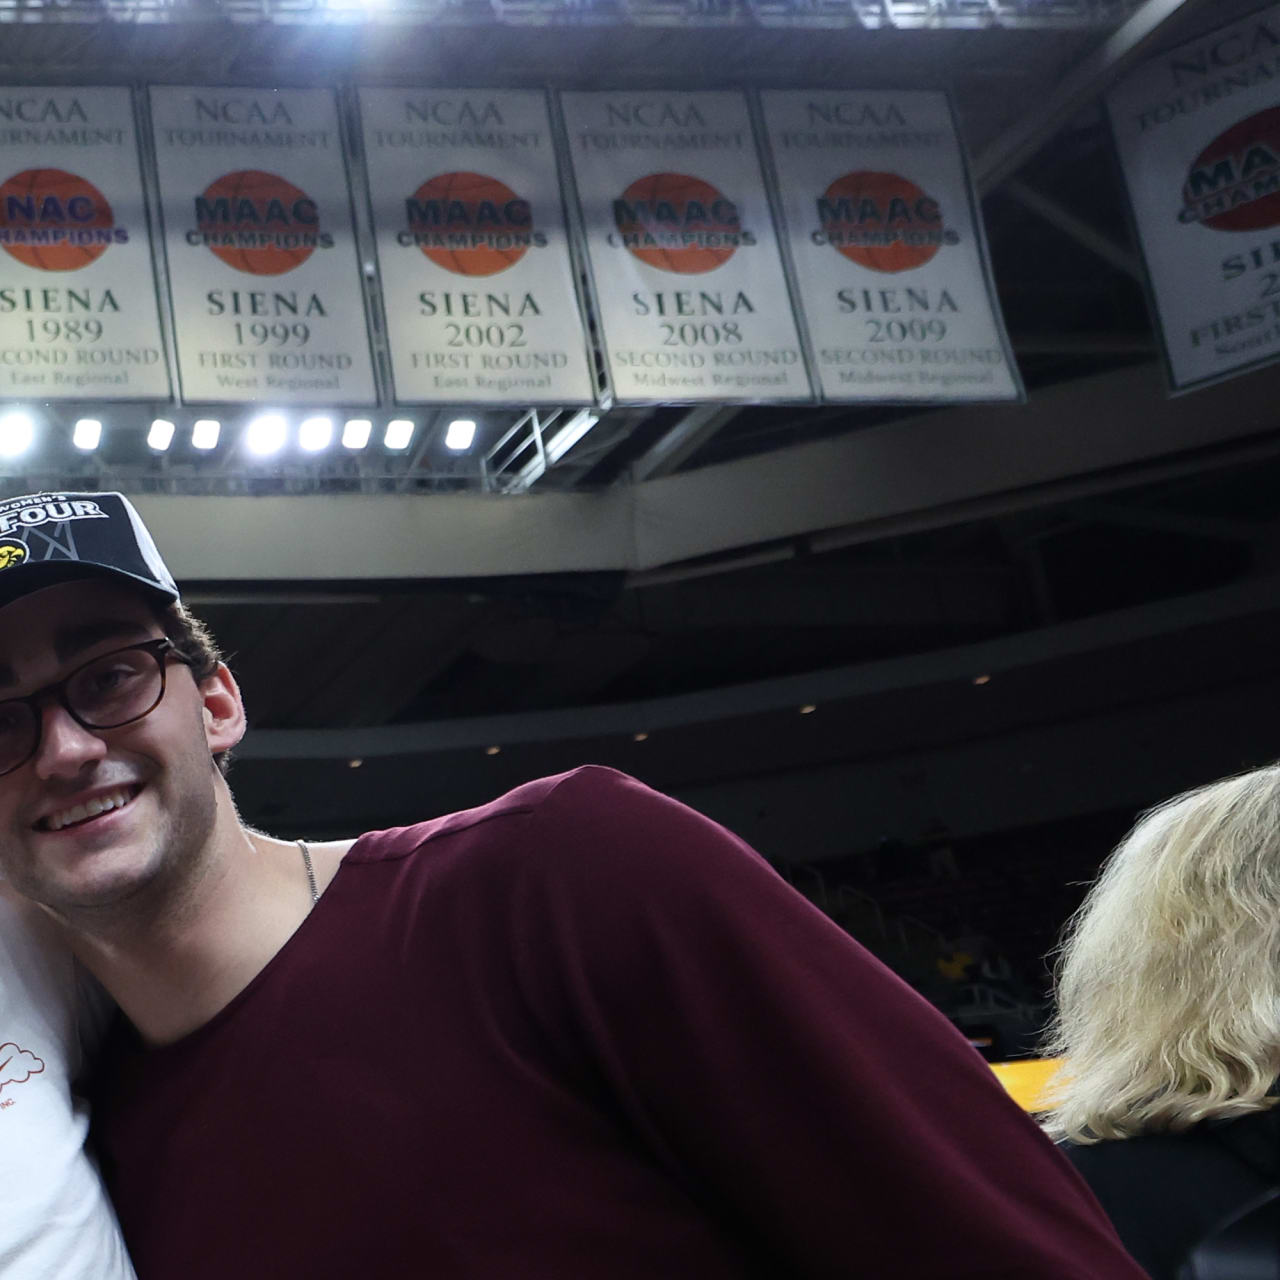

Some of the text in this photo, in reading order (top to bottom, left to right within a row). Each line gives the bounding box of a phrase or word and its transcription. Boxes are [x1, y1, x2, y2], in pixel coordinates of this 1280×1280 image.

[1137, 56, 1280, 132] TOURNA
[197, 99, 295, 126] NCAA
[404, 101, 505, 126] NCAA
[607, 103, 705, 127] NCAA
[808, 102, 907, 127] NCAA
[166, 129, 329, 148] TOURNAMENT
[376, 131, 542, 149] TOURNAMENT
[581, 132, 742, 149] TOURNAMENT
[5, 195, 96, 222] NAC
[195, 196, 320, 226] MAAC
[404, 199, 532, 227] MAAC
[612, 199, 741, 227] MAAC
[816, 197, 940, 225] MAAC
[185, 231, 335, 249] CHAMPIONS
[396, 231, 547, 249] CHAMPIONS
[607, 231, 758, 250] CHAMPIONS
[205, 288, 329, 318] SIENA
[416, 290, 545, 318] SIENA
[632, 289, 757, 317] SIENA
[836, 287, 960, 314] SIENA
[25, 320, 106, 344] 1989
[235, 321, 312, 347] 1999
[442, 322, 529, 349] 2002
[659, 323, 744, 347] 2008
[864, 319, 948, 343] 2009
[75, 348, 160, 365] ROUND
[198, 350, 353, 372] FIRST ROUND
[411, 351, 569, 370] FIRST ROUND
[615, 350, 798, 368] SECOND ROUND
[821, 348, 1000, 366] SECOND ROUND
